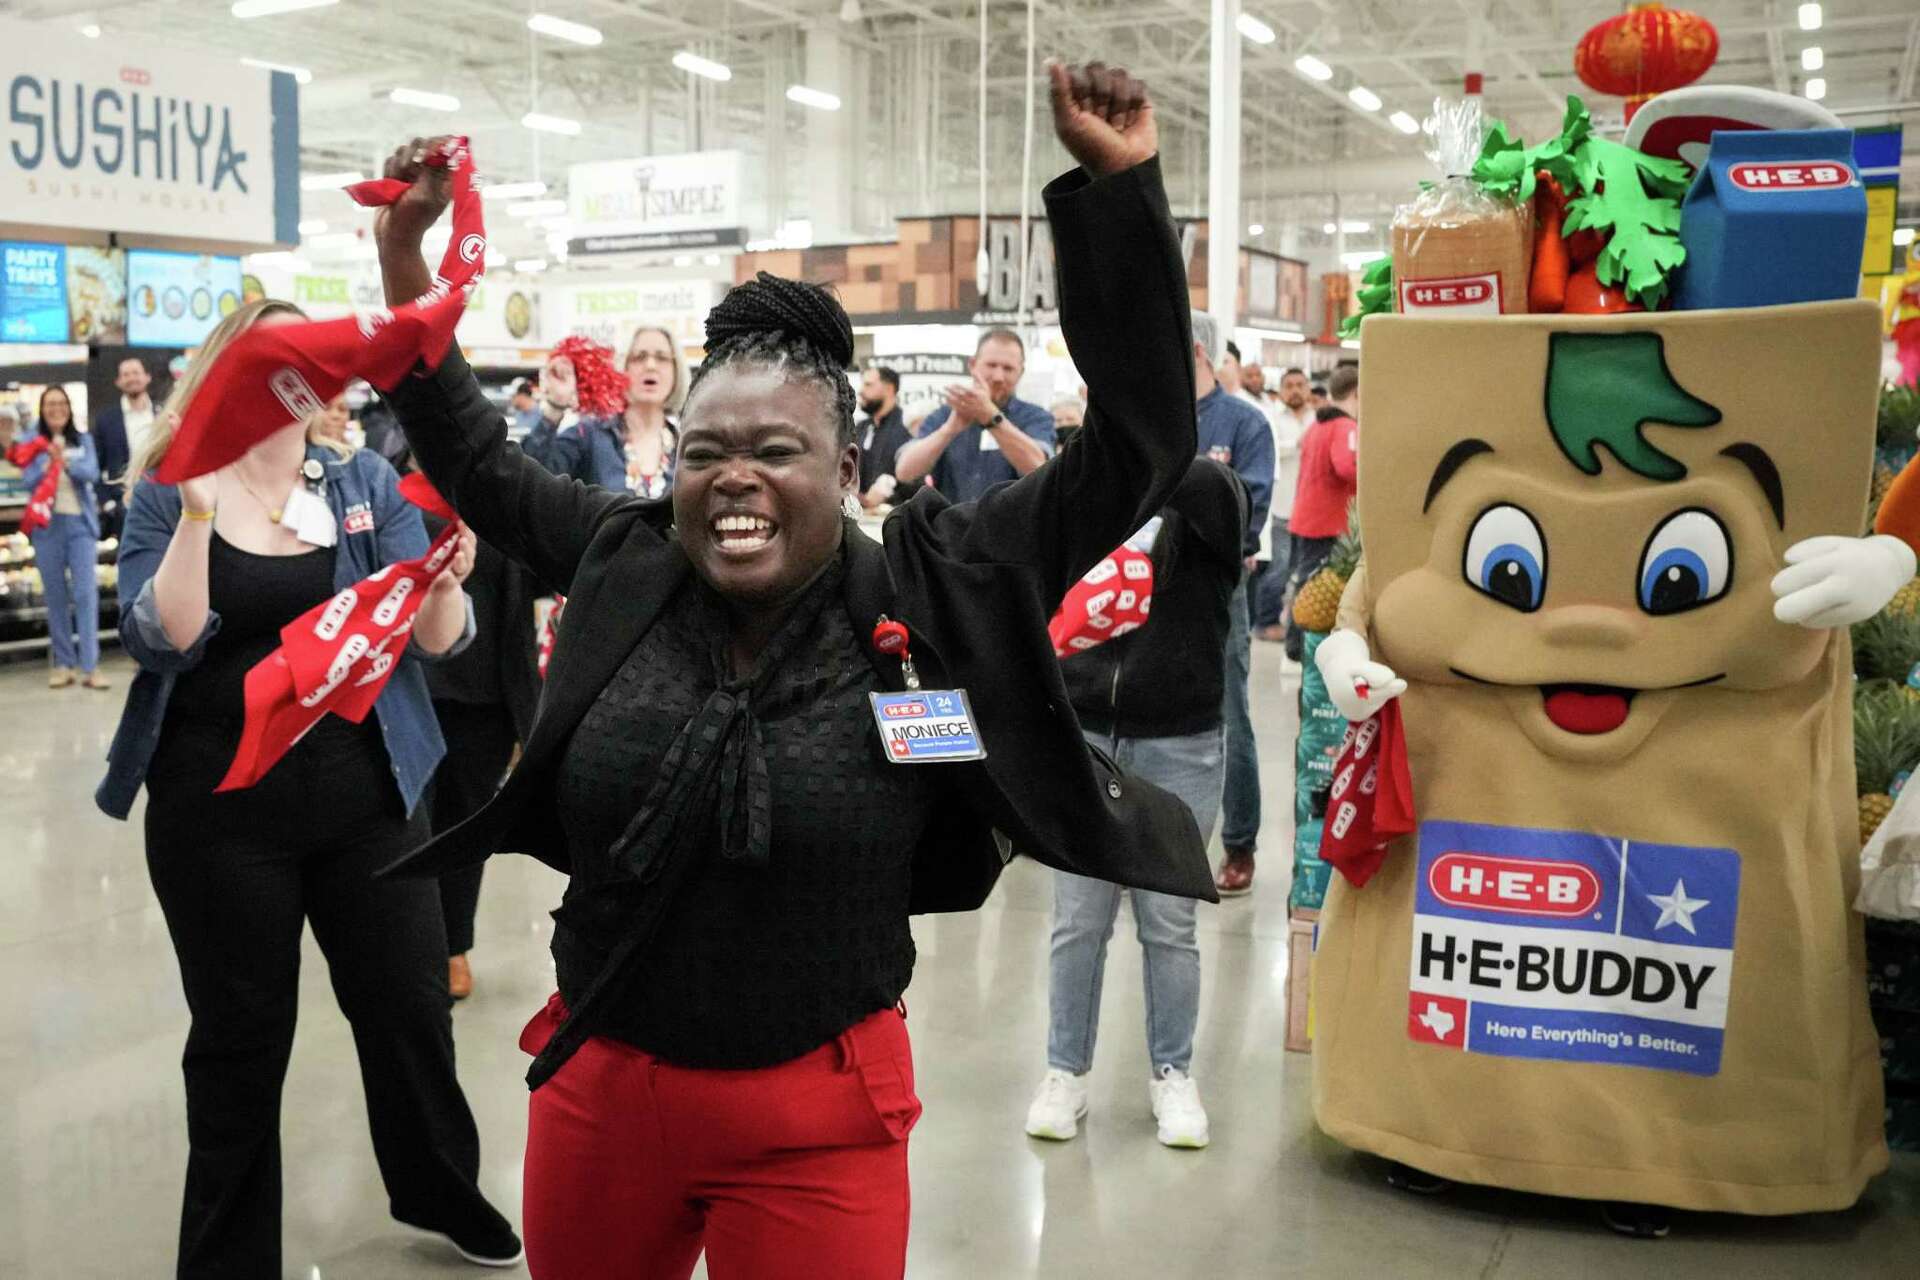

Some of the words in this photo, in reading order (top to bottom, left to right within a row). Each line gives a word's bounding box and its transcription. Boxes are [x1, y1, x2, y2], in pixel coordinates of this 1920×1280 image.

[5, 248, 59, 267] PARTY
[892, 722, 972, 741] MONIECE
[1486, 1020, 1527, 1040] Here
[1531, 1025, 1633, 1048] Everything's
[1638, 1034, 1699, 1055] Better.
